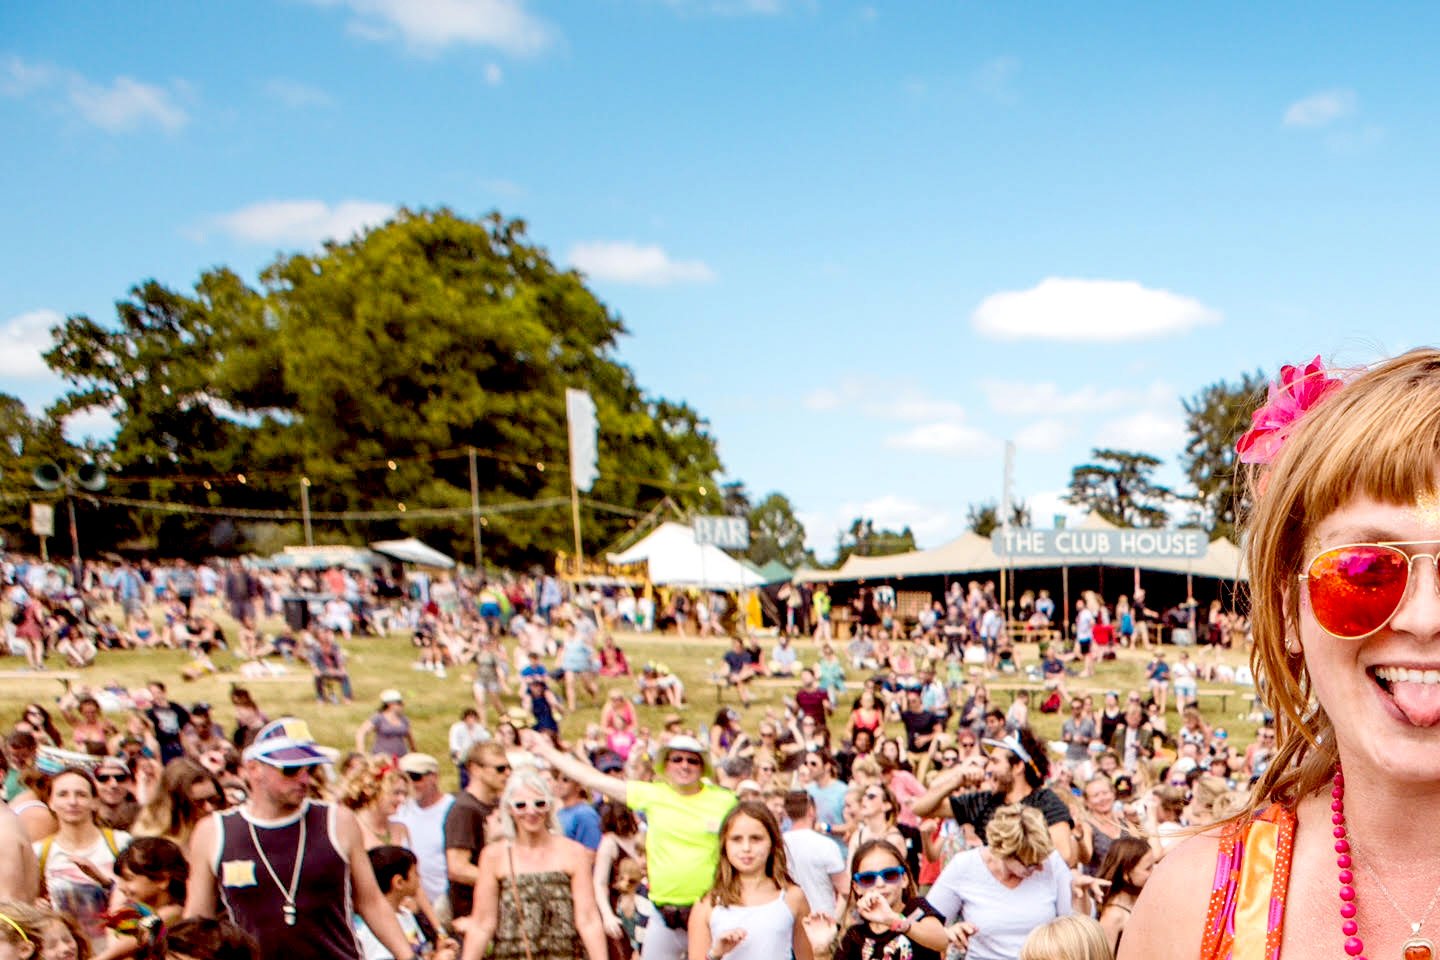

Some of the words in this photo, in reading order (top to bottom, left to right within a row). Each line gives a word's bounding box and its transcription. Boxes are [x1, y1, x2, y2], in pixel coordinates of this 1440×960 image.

[695, 517, 747, 545] BAR
[1004, 532, 1045, 553] THE
[1055, 532, 1110, 553] CLUB
[1120, 532, 1198, 555] HOUSE
